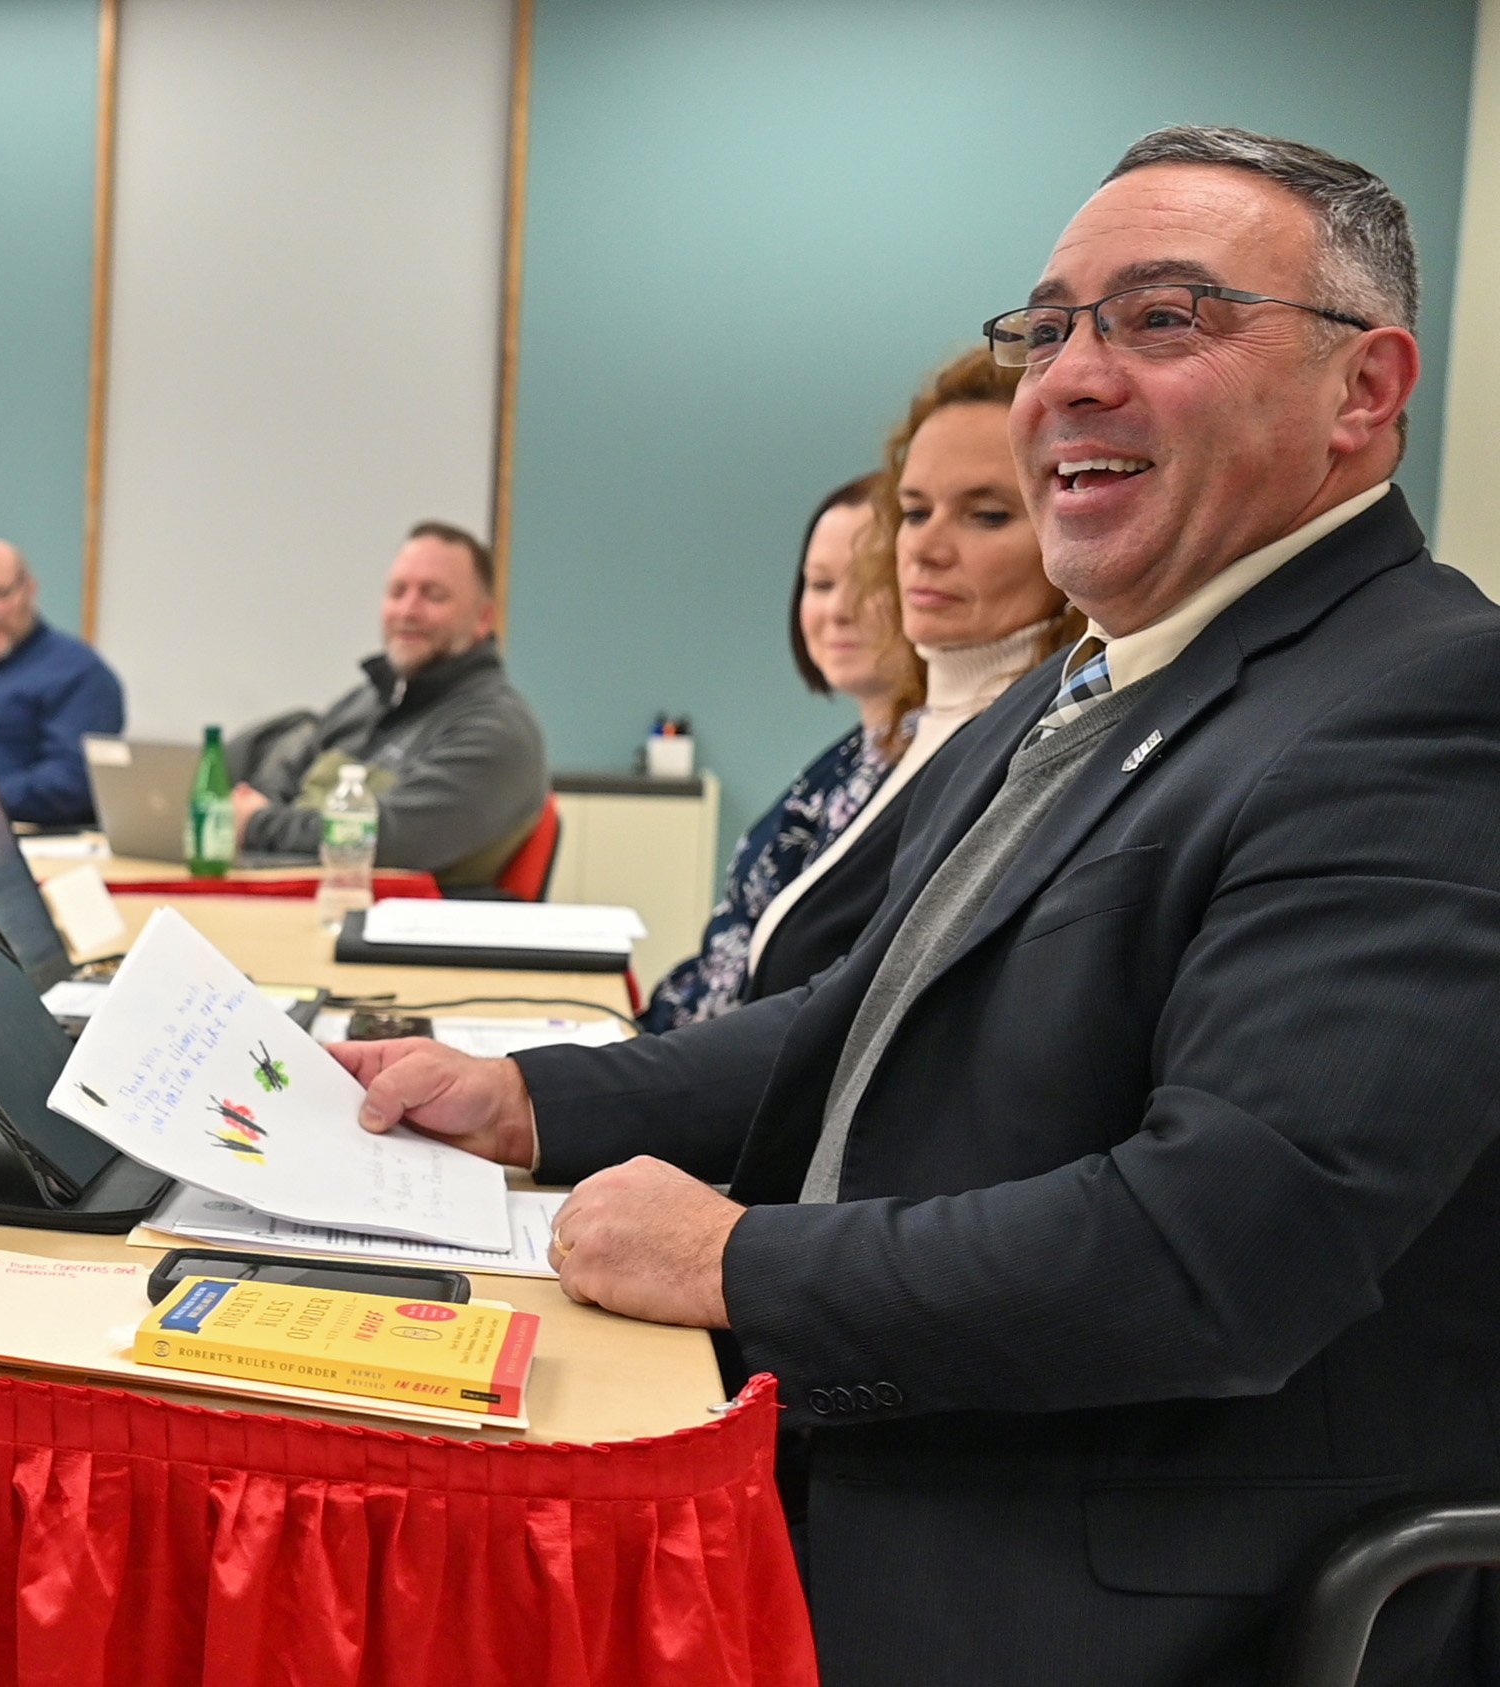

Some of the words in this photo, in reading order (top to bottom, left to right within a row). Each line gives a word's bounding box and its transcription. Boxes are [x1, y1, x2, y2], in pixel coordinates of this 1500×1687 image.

[114, 1265, 137, 1275] and
[213, 1290, 263, 1329] ROBERT'S
[255, 1299, 294, 1328] RULES
[296, 1297, 334, 1327] ORDER
[359, 1310, 385, 1333] BRIEF
[287, 1326, 313, 1340] OF
[354, 1332, 374, 1342] IN
[179, 1347, 233, 1364] ROBERT'S
[237, 1356, 275, 1370] RULES
[279, 1362, 295, 1372] OF
[298, 1365, 338, 1379] ORDER
[346, 1379, 386, 1391] REVISED
[351, 1369, 383, 1380] NEWLY
[394, 1380, 410, 1390] IN
[413, 1382, 450, 1396] BRIEF
